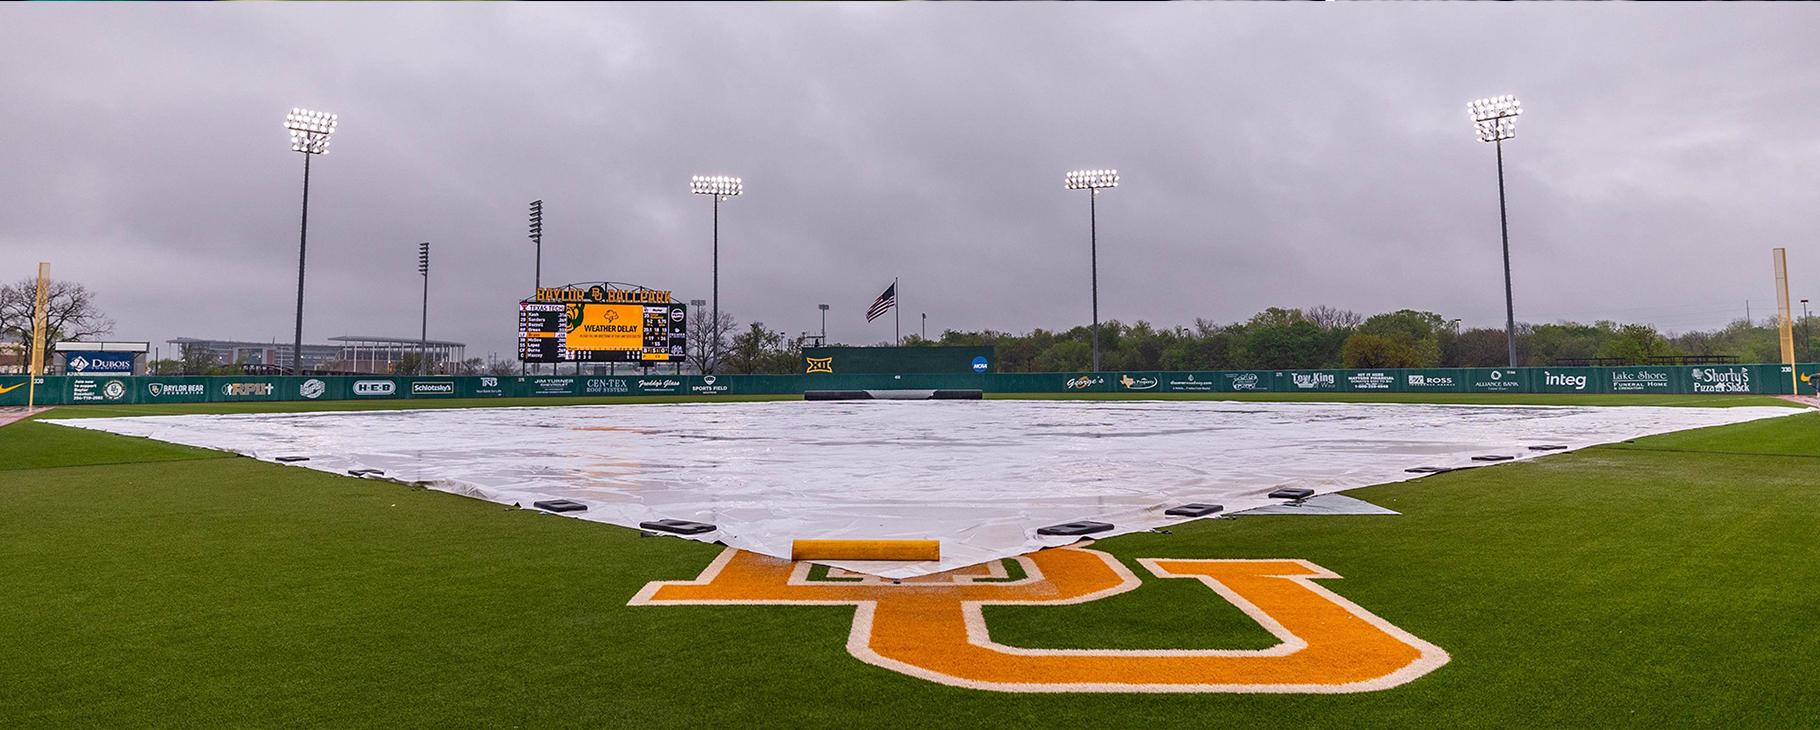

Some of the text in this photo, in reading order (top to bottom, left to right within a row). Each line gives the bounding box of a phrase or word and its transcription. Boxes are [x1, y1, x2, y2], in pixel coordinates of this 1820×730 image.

[537, 288, 584, 301] BAYLOR
[608, 289, 672, 303] BALLPARK
[1292, 373, 1334, 384] Tow King
[1544, 371, 1586, 389] integ
[1613, 371, 1667, 380] Lake Shore
[1704, 368, 1749, 385] Shorty's
[587, 379, 627, 387] CEN-TEX
[663, 380, 680, 388] Glass
[1067, 376, 1104, 389] George's
[1694, 382, 1750, 392] Pizza Shack
